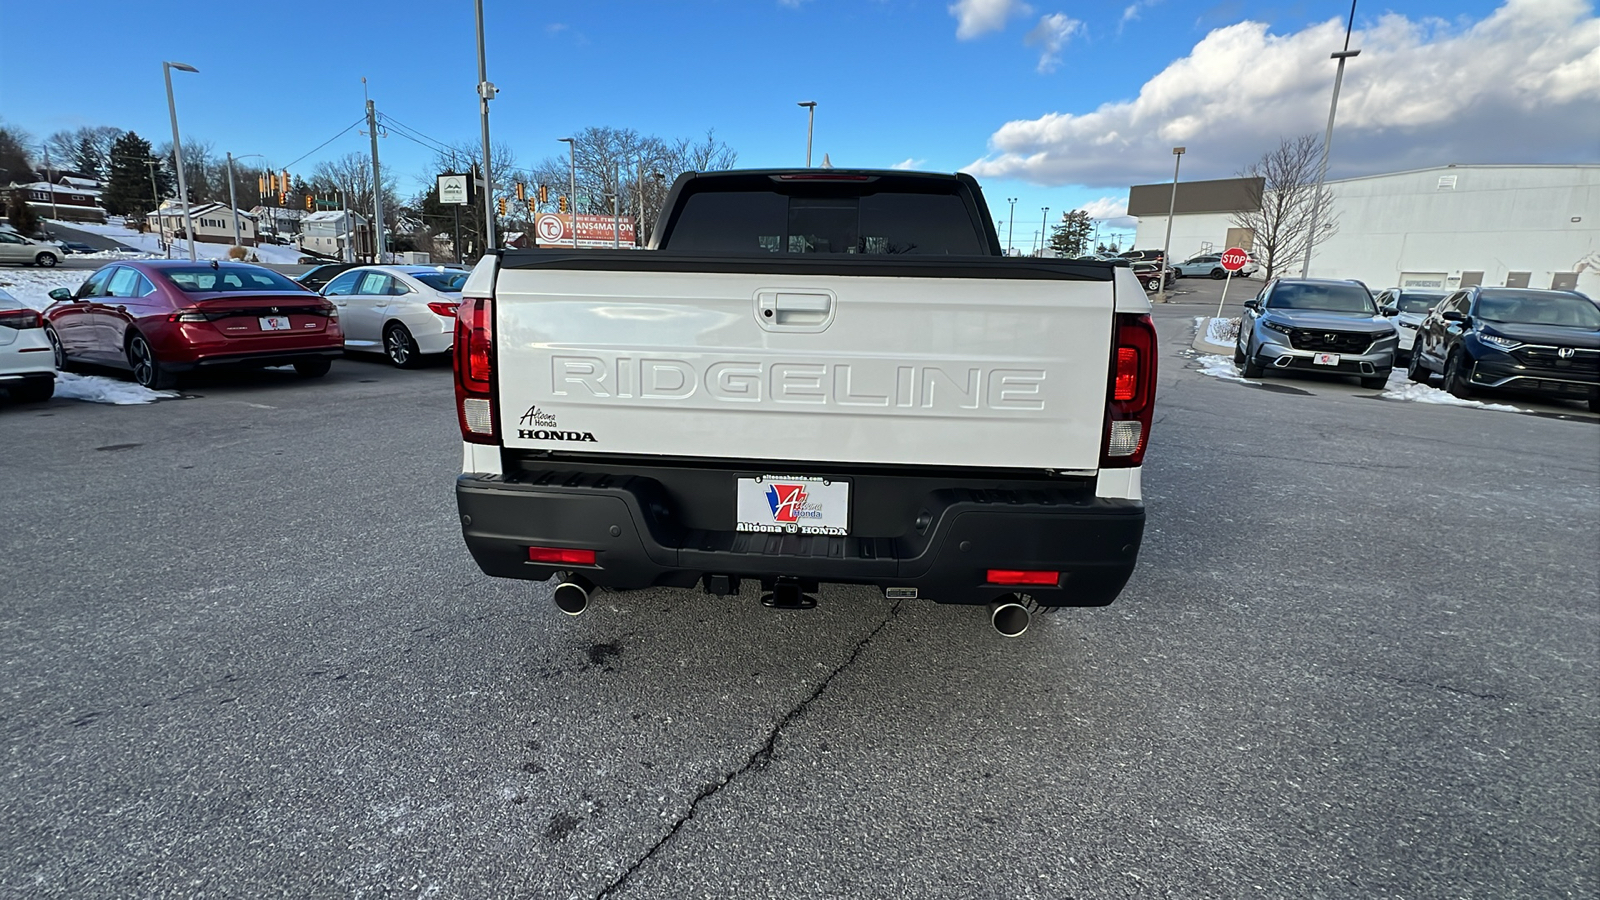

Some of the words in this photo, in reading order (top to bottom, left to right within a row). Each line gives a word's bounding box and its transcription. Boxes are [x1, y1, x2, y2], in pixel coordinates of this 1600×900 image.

[565, 221, 633, 231] TRANS4MATON
[1222, 254, 1246, 265] STOP
[551, 355, 1046, 410] RIDGELINE
[535, 420, 557, 428] Honda
[517, 429, 598, 442] HONDA
[793, 509, 822, 518] Honda
[736, 522, 782, 533] Altoona
[801, 526, 848, 536] HONDA
